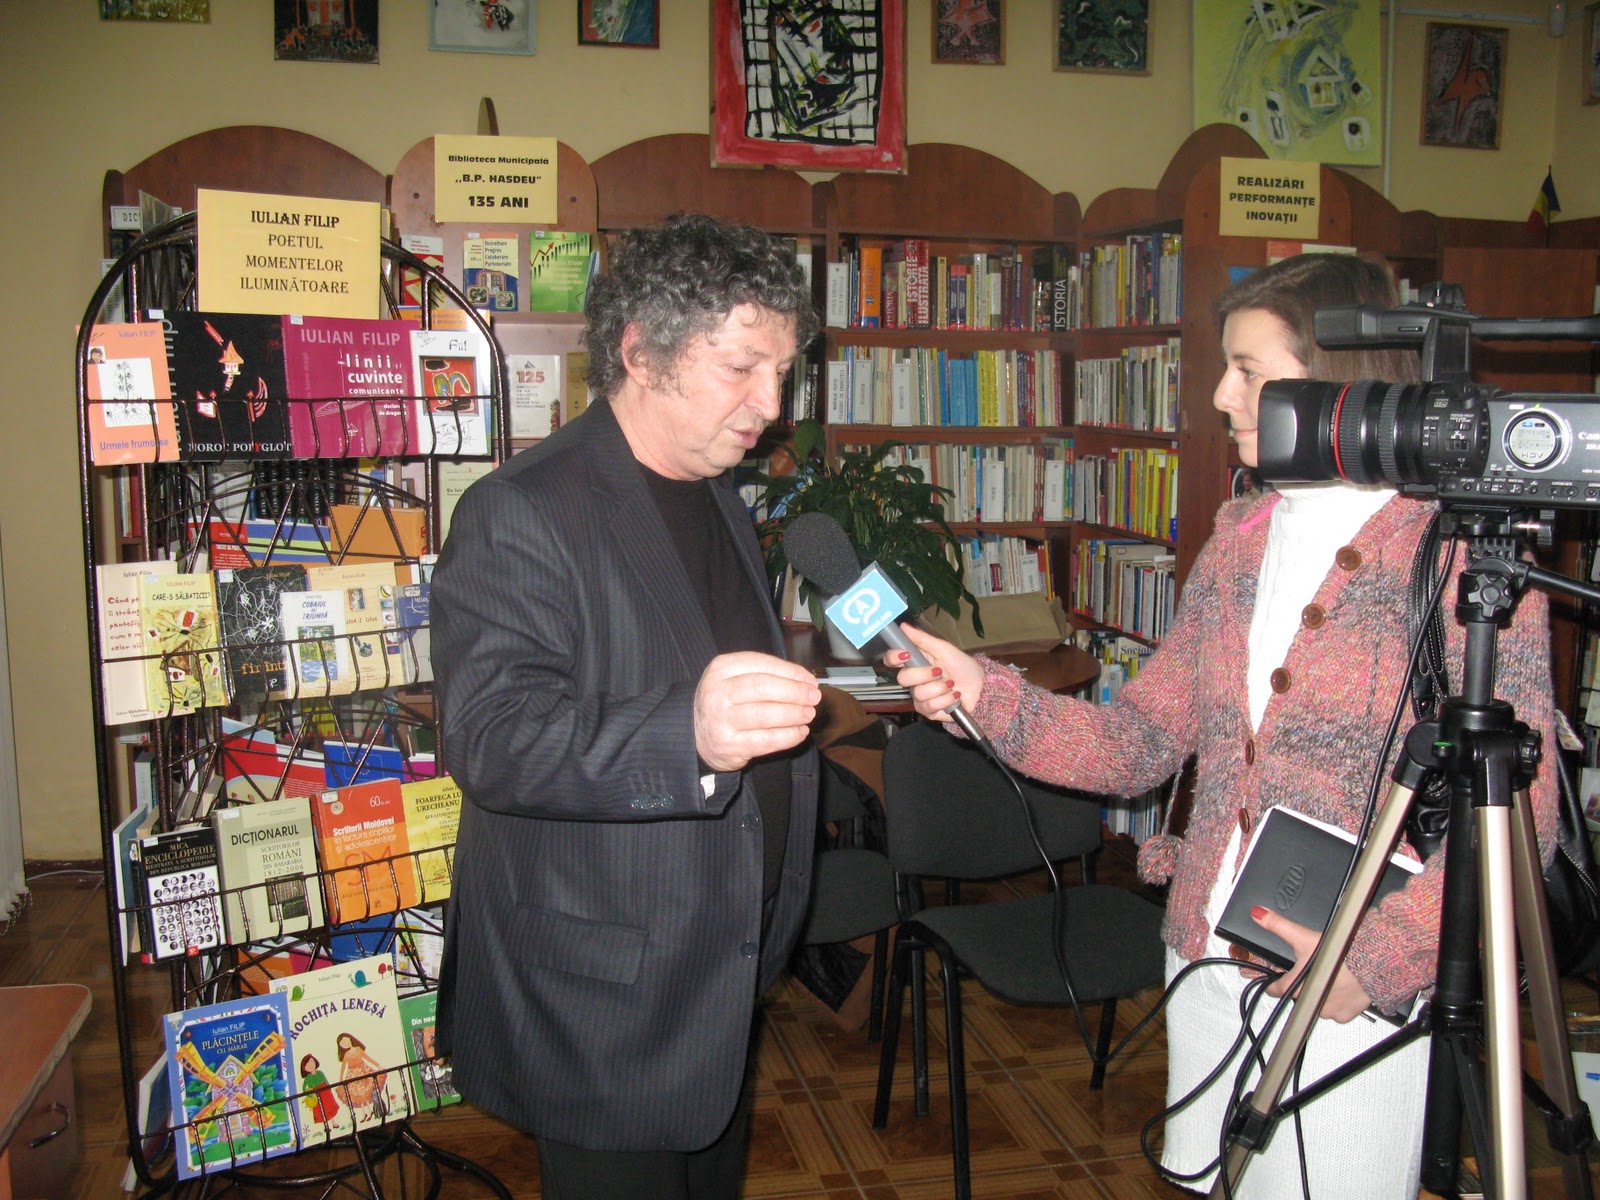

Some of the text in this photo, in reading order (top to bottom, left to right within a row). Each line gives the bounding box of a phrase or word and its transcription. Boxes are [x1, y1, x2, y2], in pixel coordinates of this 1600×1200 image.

[448, 155, 496, 163] Biblioteca
[1237, 176, 1305, 190] REALIZĂRI
[468, 196, 529, 208] 135 ANI
[1229, 192, 1315, 208] PERFORMANȚE
[123, 212, 141, 222] DIC
[251, 210, 340, 228] IULIAN FILIP
[1246, 211, 1298, 225] INOVAȚII
[268, 234, 323, 249] POETUL
[246, 255, 343, 272] MOMENTELOR
[240, 277, 349, 294] ILUMINĂTOARE
[907, 256, 918, 303] ISTORIE
[886, 291, 894, 325] ISTORIA
[1055, 279, 1067, 330] ISTORIA
[301, 329, 400, 346] IULIAN FILIP
[348, 370, 403, 384] cuvinte
[516, 370, 545, 384] 125
[349, 387, 404, 395] comunicante
[1578, 431, 1600, 440] Can
[100, 440, 129, 451] Urmele
[152, 593, 173, 601] CARE-S
[241, 663, 261, 675] fir
[369, 795, 380, 808] 60
[415, 793, 452, 805] FOARFECA
[333, 816, 395, 837] Scriitorii Moldovei
[231, 824, 299, 846] DICȚIONARUL
[343, 831, 367, 843] lectura
[261, 841, 300, 853] SCRIITORILOR
[144, 844, 216, 865] ENCICLOPEDIE
[262, 848, 302, 863] ROMÂNI
[274, 858, 302, 868] BASARABIA
[264, 864, 304, 877] 1812-2006
[290, 998, 387, 1041] ROCHIȚA LENEȘĂ
[411, 1017, 423, 1026] Din
[212, 1022, 246, 1035] Iulian FILIP
[202, 1030, 259, 1050] PLĂCINȚELE
